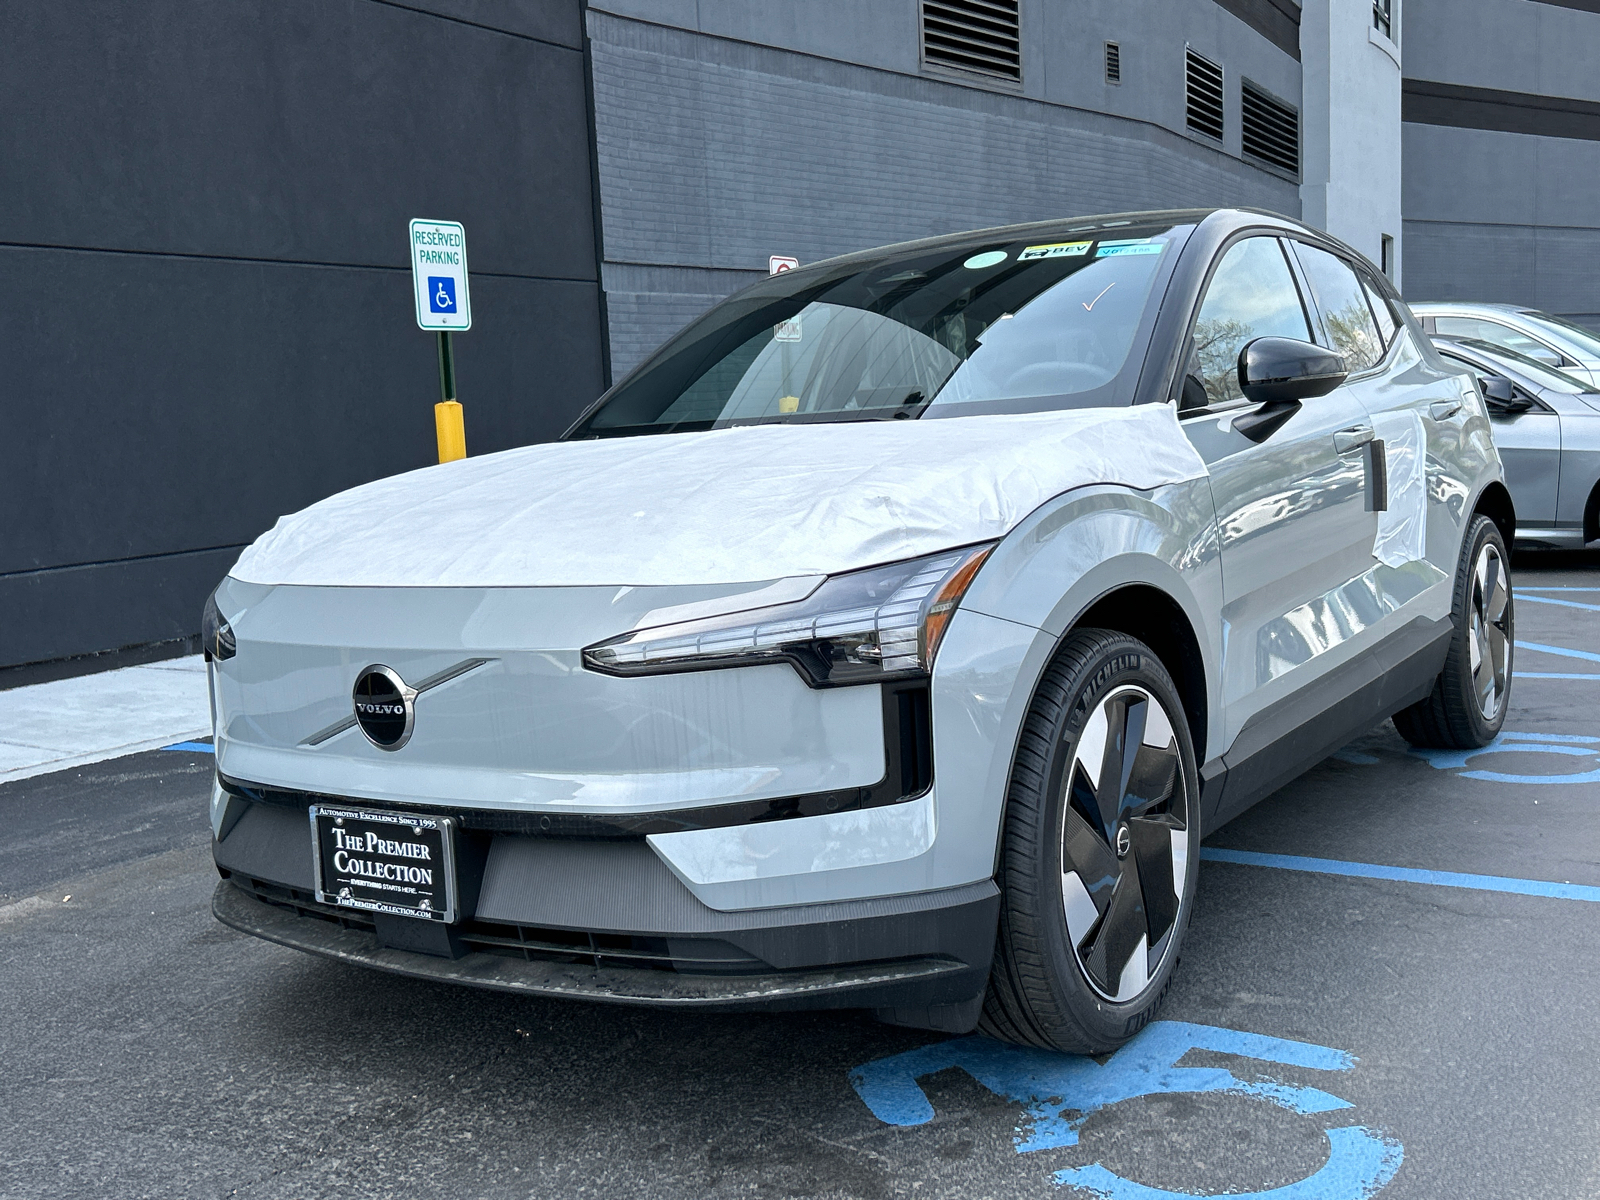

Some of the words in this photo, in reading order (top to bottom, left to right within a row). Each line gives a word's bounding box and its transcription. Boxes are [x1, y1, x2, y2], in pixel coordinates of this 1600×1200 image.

[415, 231, 461, 247] RESERVED
[420, 250, 460, 265] PARKING
[1052, 245, 1087, 255] BEV
[1082, 655, 1138, 708] MICHELIN
[357, 703, 404, 715] VOLVO
[319, 808, 359, 819] AUTOMOTIVE
[359, 812, 398, 823] EXCELLENCE
[398, 816, 418, 826] SINCE
[419, 819, 437, 828] 1995
[332, 828, 364, 851] THE
[364, 832, 432, 860] PREMIER
[334, 851, 433, 885] COLLECTION
[382, 884, 401, 892] STARTS
